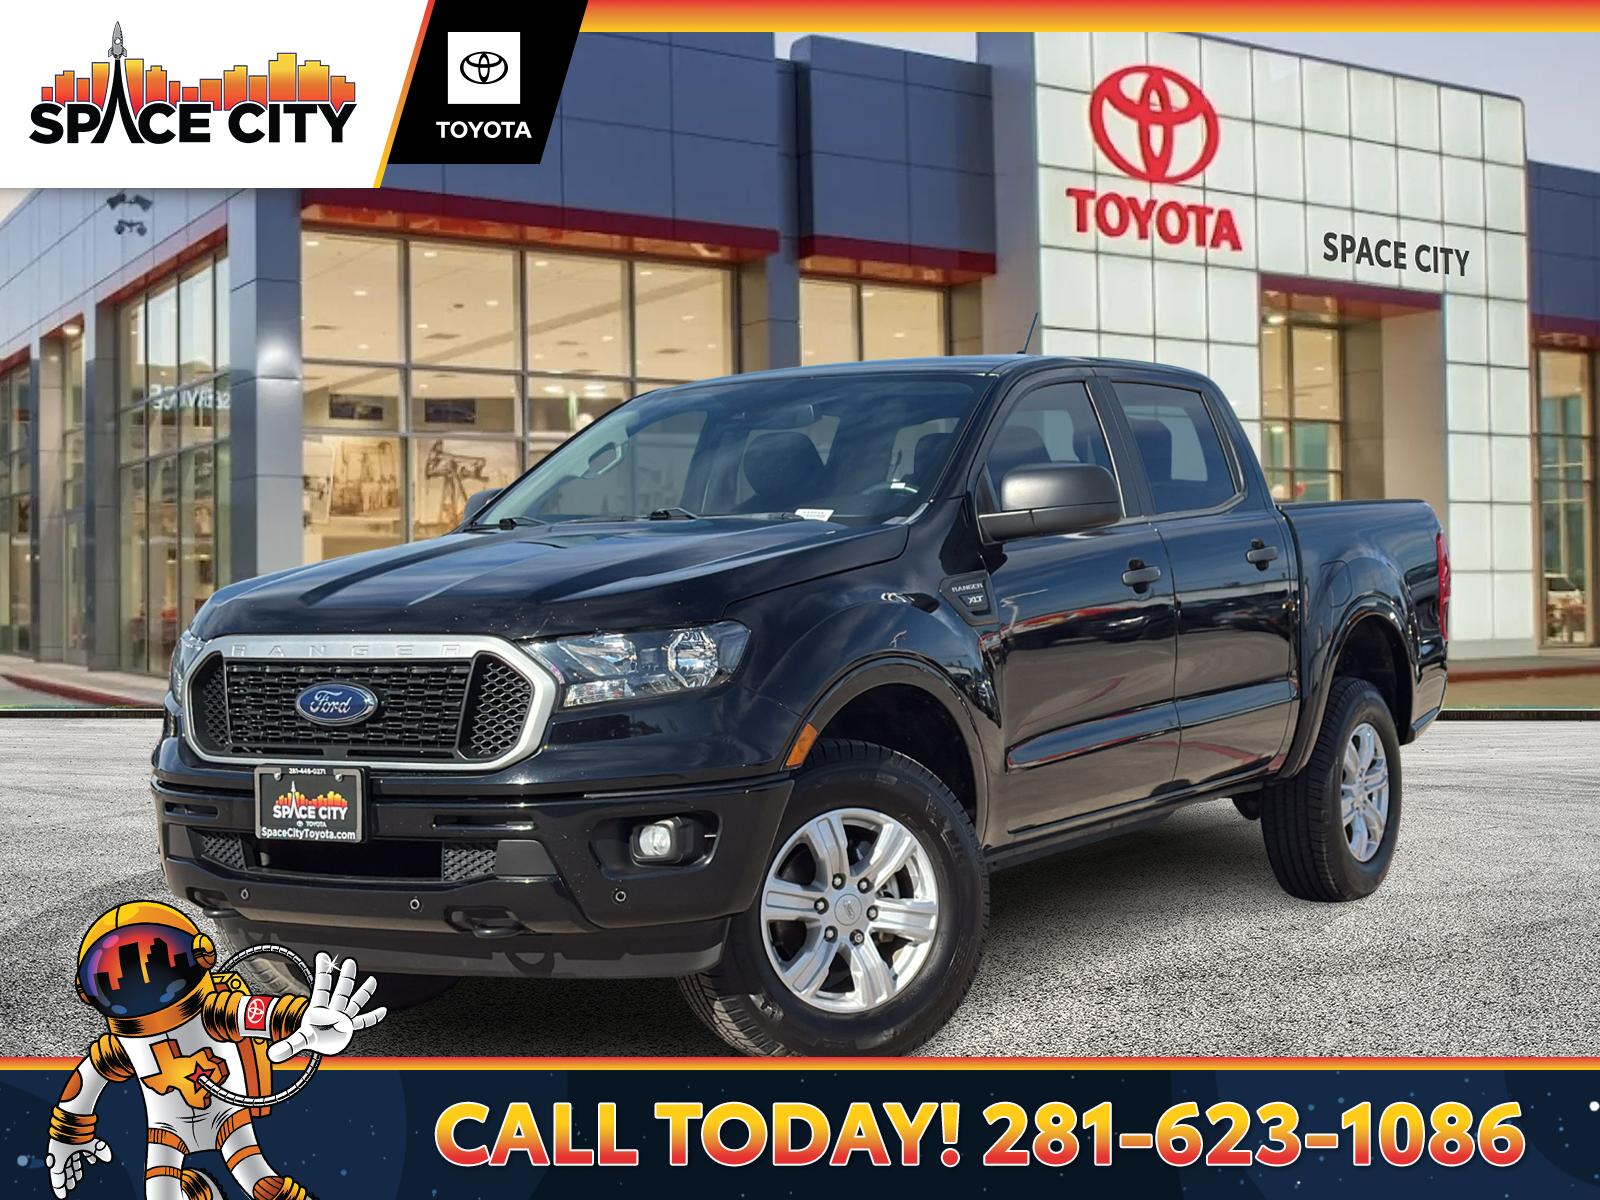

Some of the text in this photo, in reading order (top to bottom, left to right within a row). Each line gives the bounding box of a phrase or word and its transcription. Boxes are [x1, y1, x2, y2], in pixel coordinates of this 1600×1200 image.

[1066, 188, 1242, 251] TOYOTA
[1322, 231, 1470, 277] SPACE CITY
[952, 583, 983, 592] RANGER
[967, 595, 984, 604] XLT
[231, 645, 461, 657] RANGER
[309, 690, 352, 714] Ford
[318, 806, 348, 820] CITY
[261, 827, 356, 840] SpaceCityToyota.com
